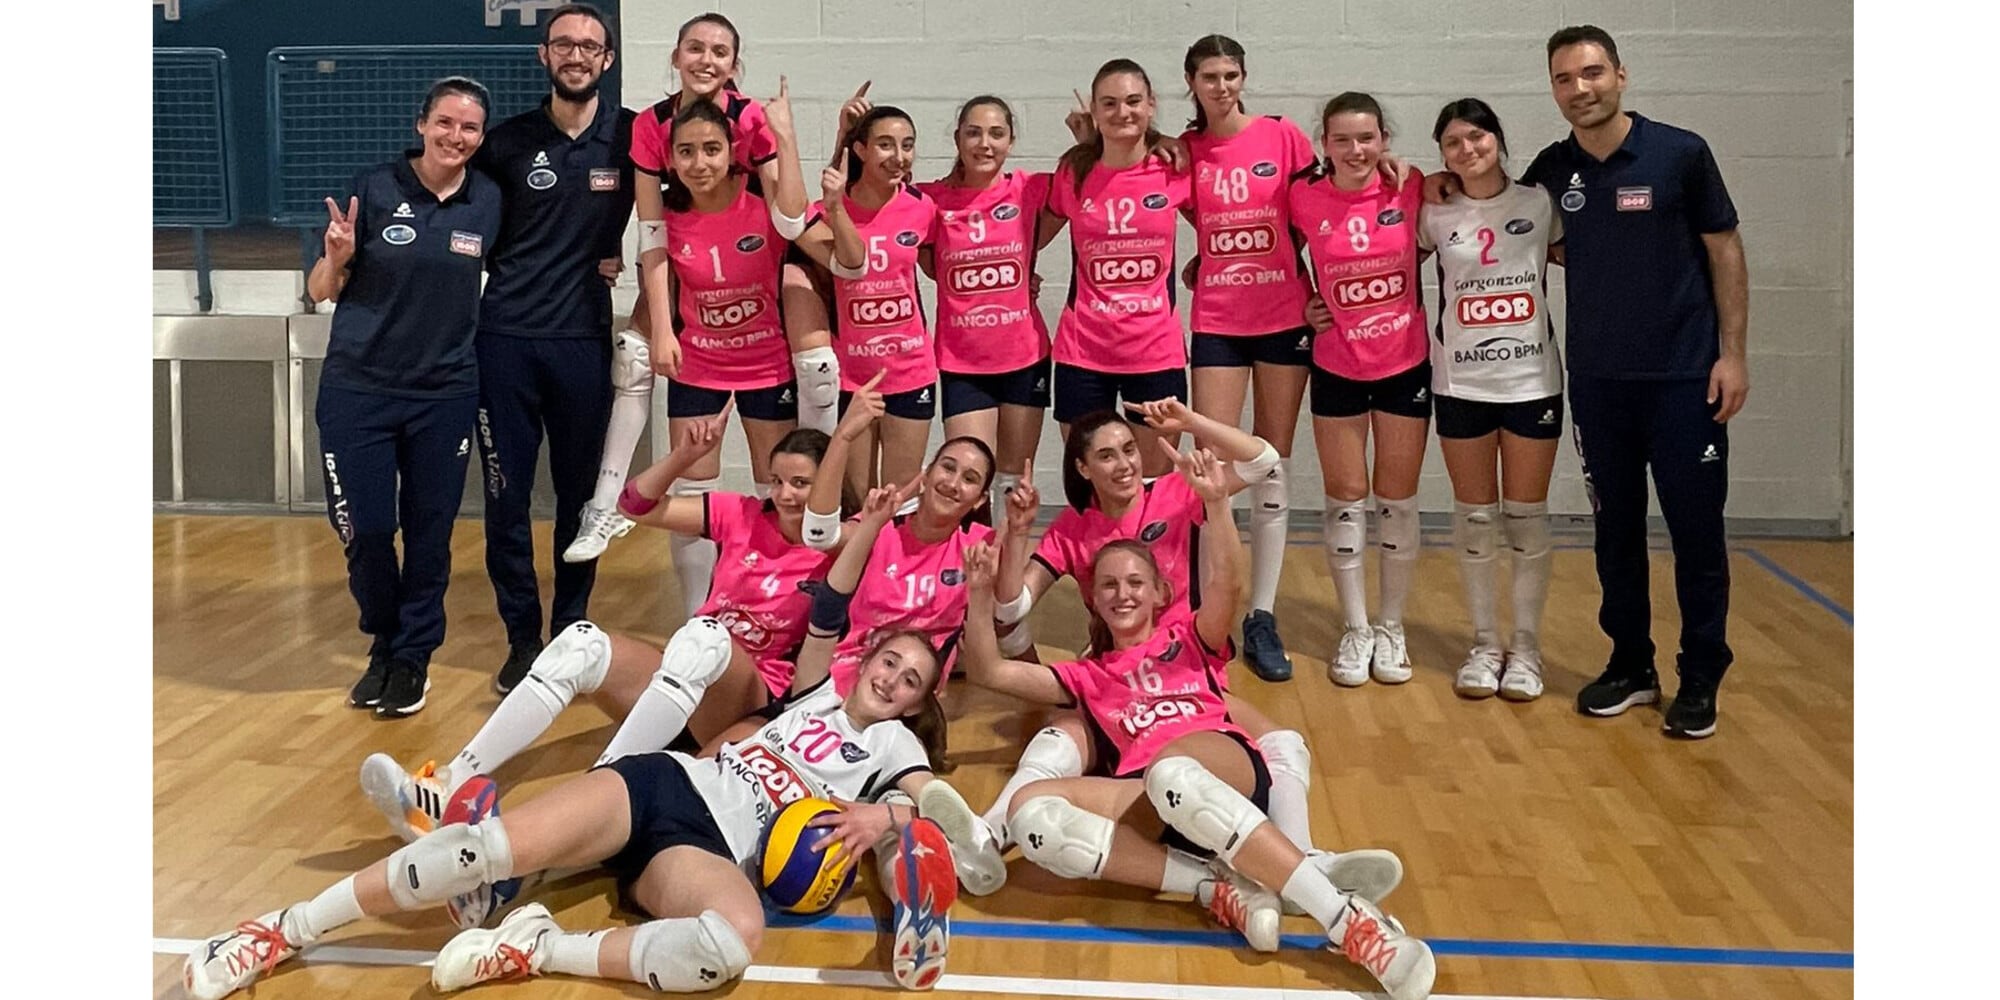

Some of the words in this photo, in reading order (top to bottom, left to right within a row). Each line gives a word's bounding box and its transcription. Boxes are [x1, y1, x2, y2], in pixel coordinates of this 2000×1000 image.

[1213, 167, 1249, 205] 48
[967, 210, 987, 243] 9
[1105, 197, 1138, 235] 12
[1202, 205, 1277, 226] Gorgonzola
[1083, 236, 1166, 254] Gorgonzola
[1210, 230, 1269, 253] IGOR
[1347, 216, 1370, 253] 8
[1476, 227, 1499, 266] 2
[709, 245, 727, 283] 1
[954, 264, 1016, 290] IGOR
[1094, 258, 1156, 281] IGOR
[1205, 273, 1253, 287] BANCO
[1255, 270, 1286, 284] BPM
[1339, 275, 1403, 304] IGOR
[701, 300, 758, 326] IGOR
[853, 297, 912, 321] IGOR
[1462, 297, 1530, 321] IGOR
[1347, 323, 1393, 341] ANCO
[847, 343, 898, 357] BANCO
[1454, 347, 1511, 363] BANCO
[1514, 342, 1544, 358] BPM
[760, 568, 783, 598] 4
[903, 573, 936, 609] 19
[1122, 657, 1163, 694] 16
[1122, 700, 1197, 736] IGOR
[788, 719, 842, 764] 20
[721, 753, 762, 797] ANCO
